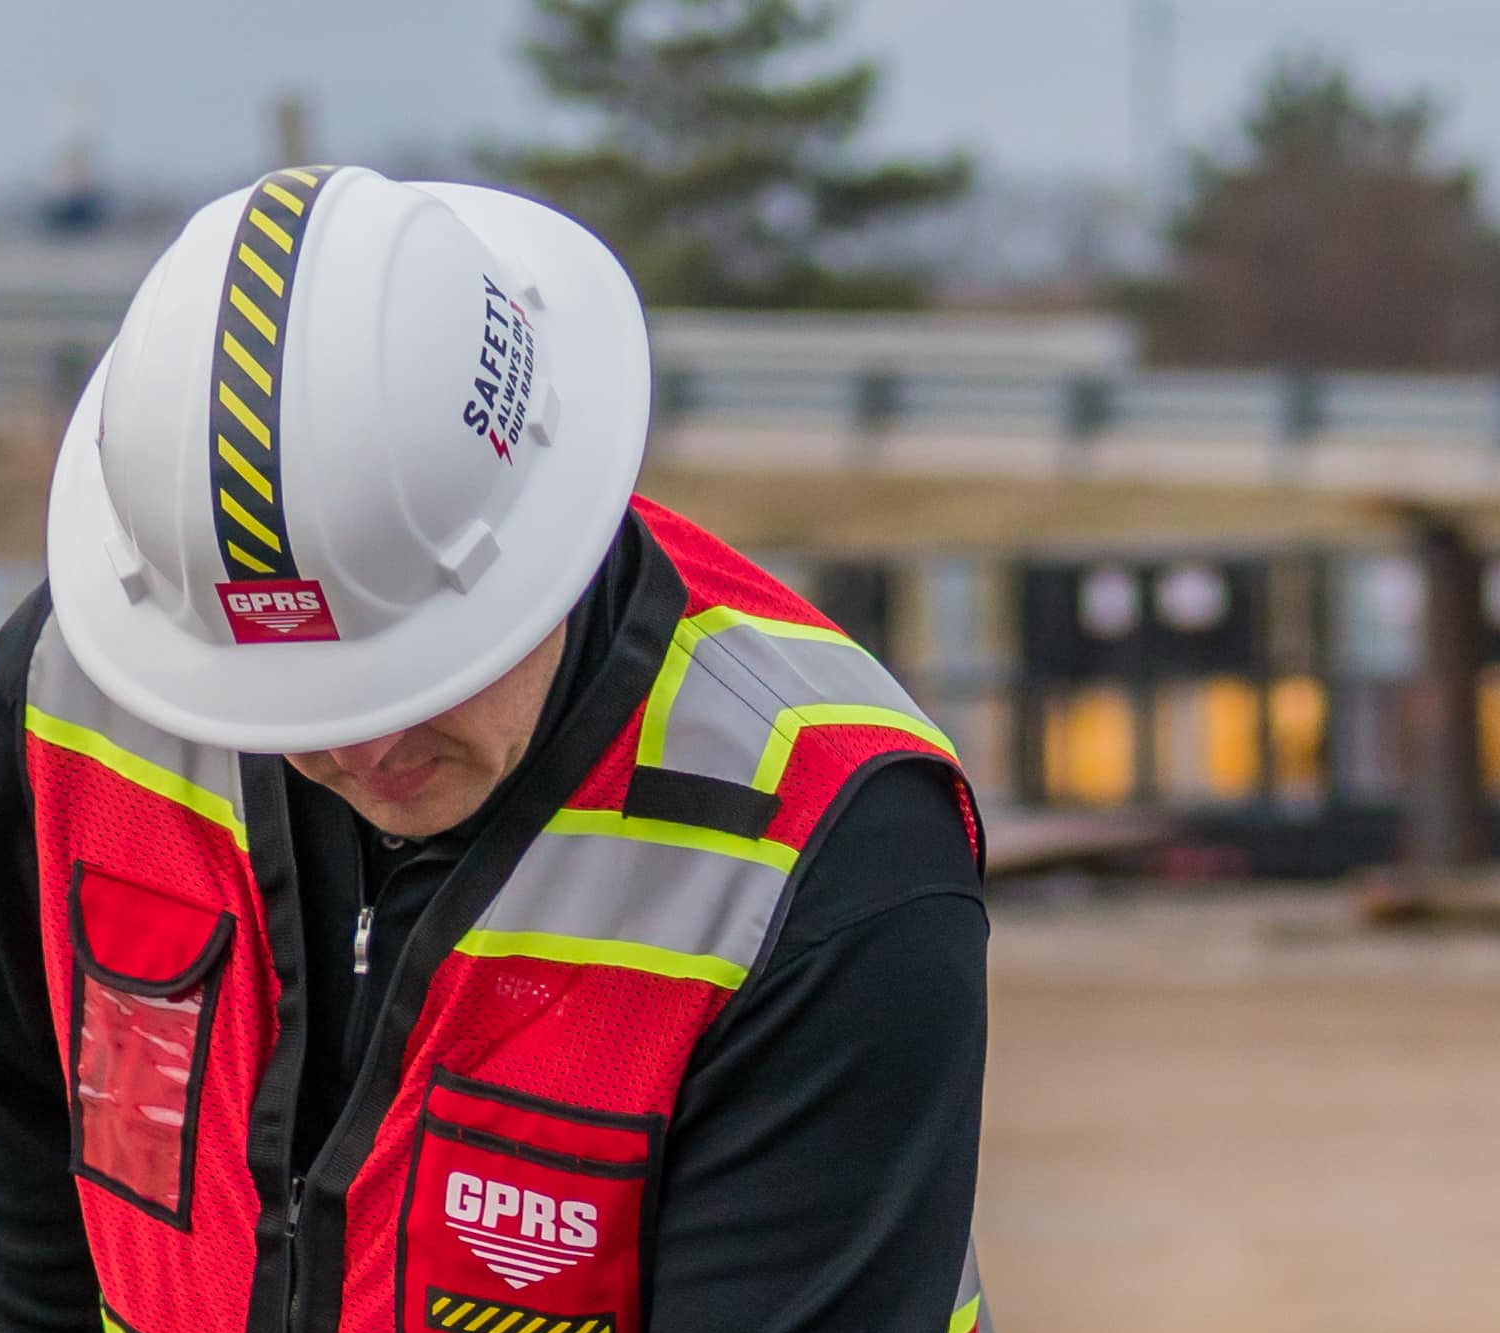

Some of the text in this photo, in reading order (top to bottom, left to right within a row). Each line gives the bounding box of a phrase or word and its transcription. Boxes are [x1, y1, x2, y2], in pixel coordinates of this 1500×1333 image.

[463, 273, 509, 436] SAFETY
[497, 315, 522, 430] ALWAYS ON
[508, 330, 535, 445] OUR RADAR
[226, 590, 320, 612] GPRS
[445, 1171, 598, 1248] GPRS
